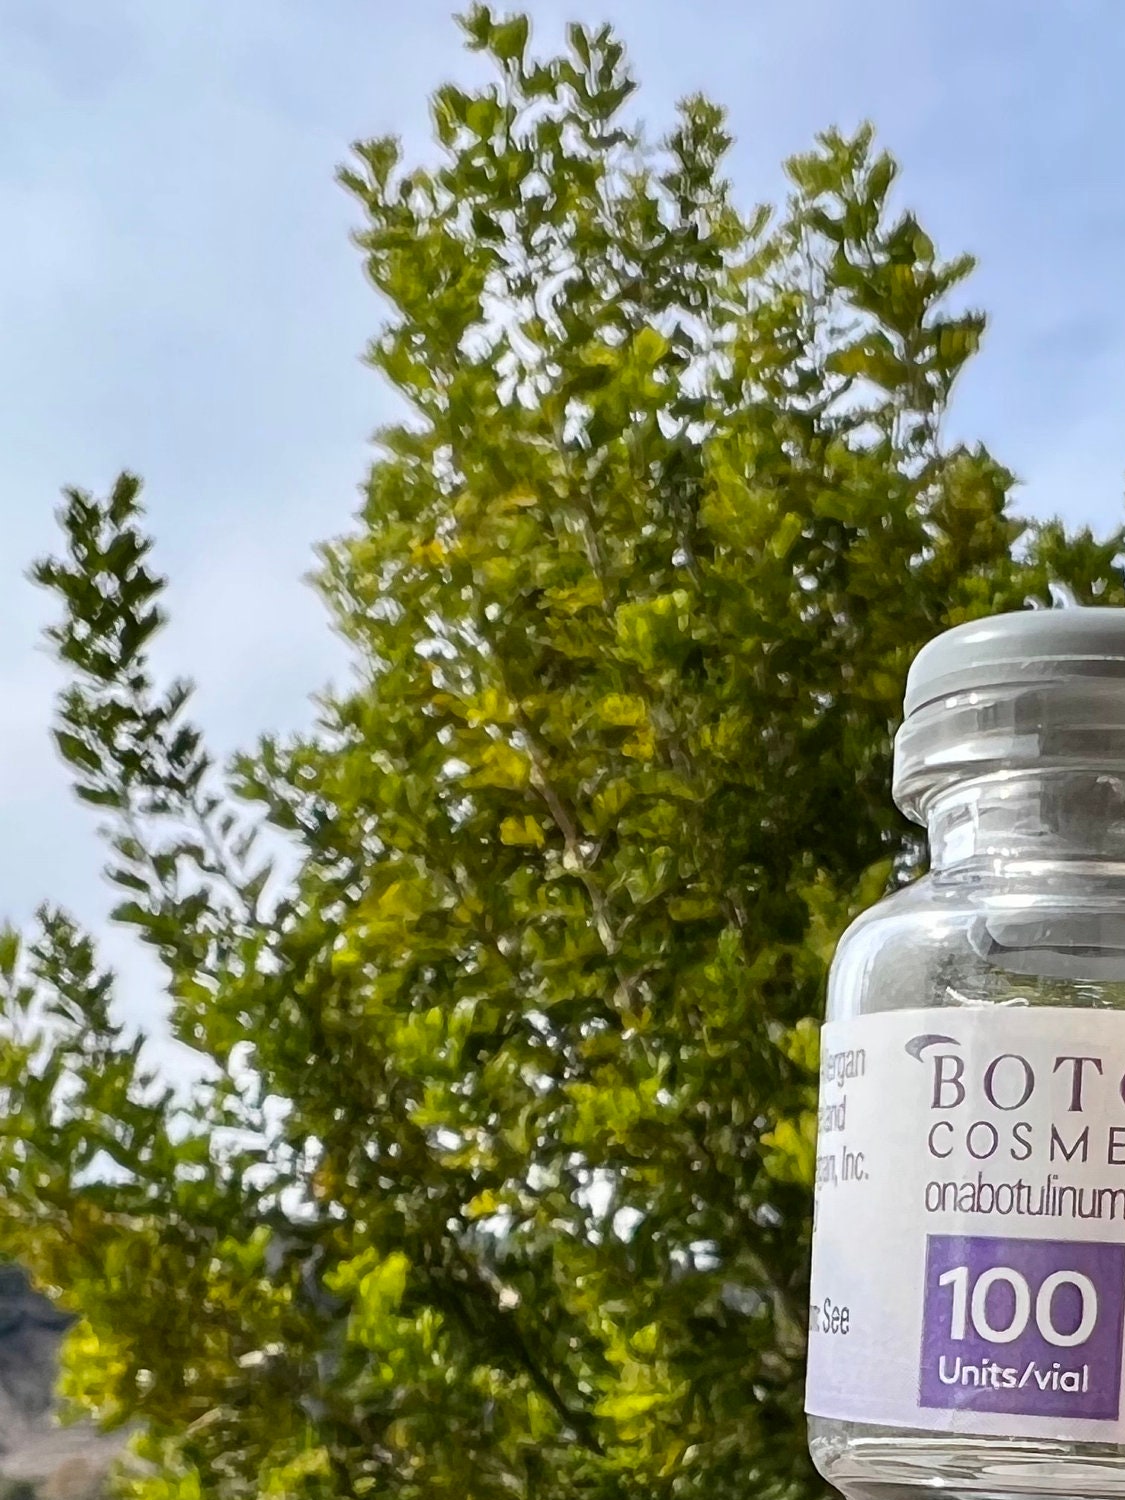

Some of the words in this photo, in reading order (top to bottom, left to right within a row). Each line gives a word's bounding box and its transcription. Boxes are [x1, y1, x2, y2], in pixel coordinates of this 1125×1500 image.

[842, 1146, 869, 1181] Inc.
[822, 1297, 850, 1335] See
[938, 1266, 1098, 1347] 100
[938, 1355, 1089, 1392] Units/vial
